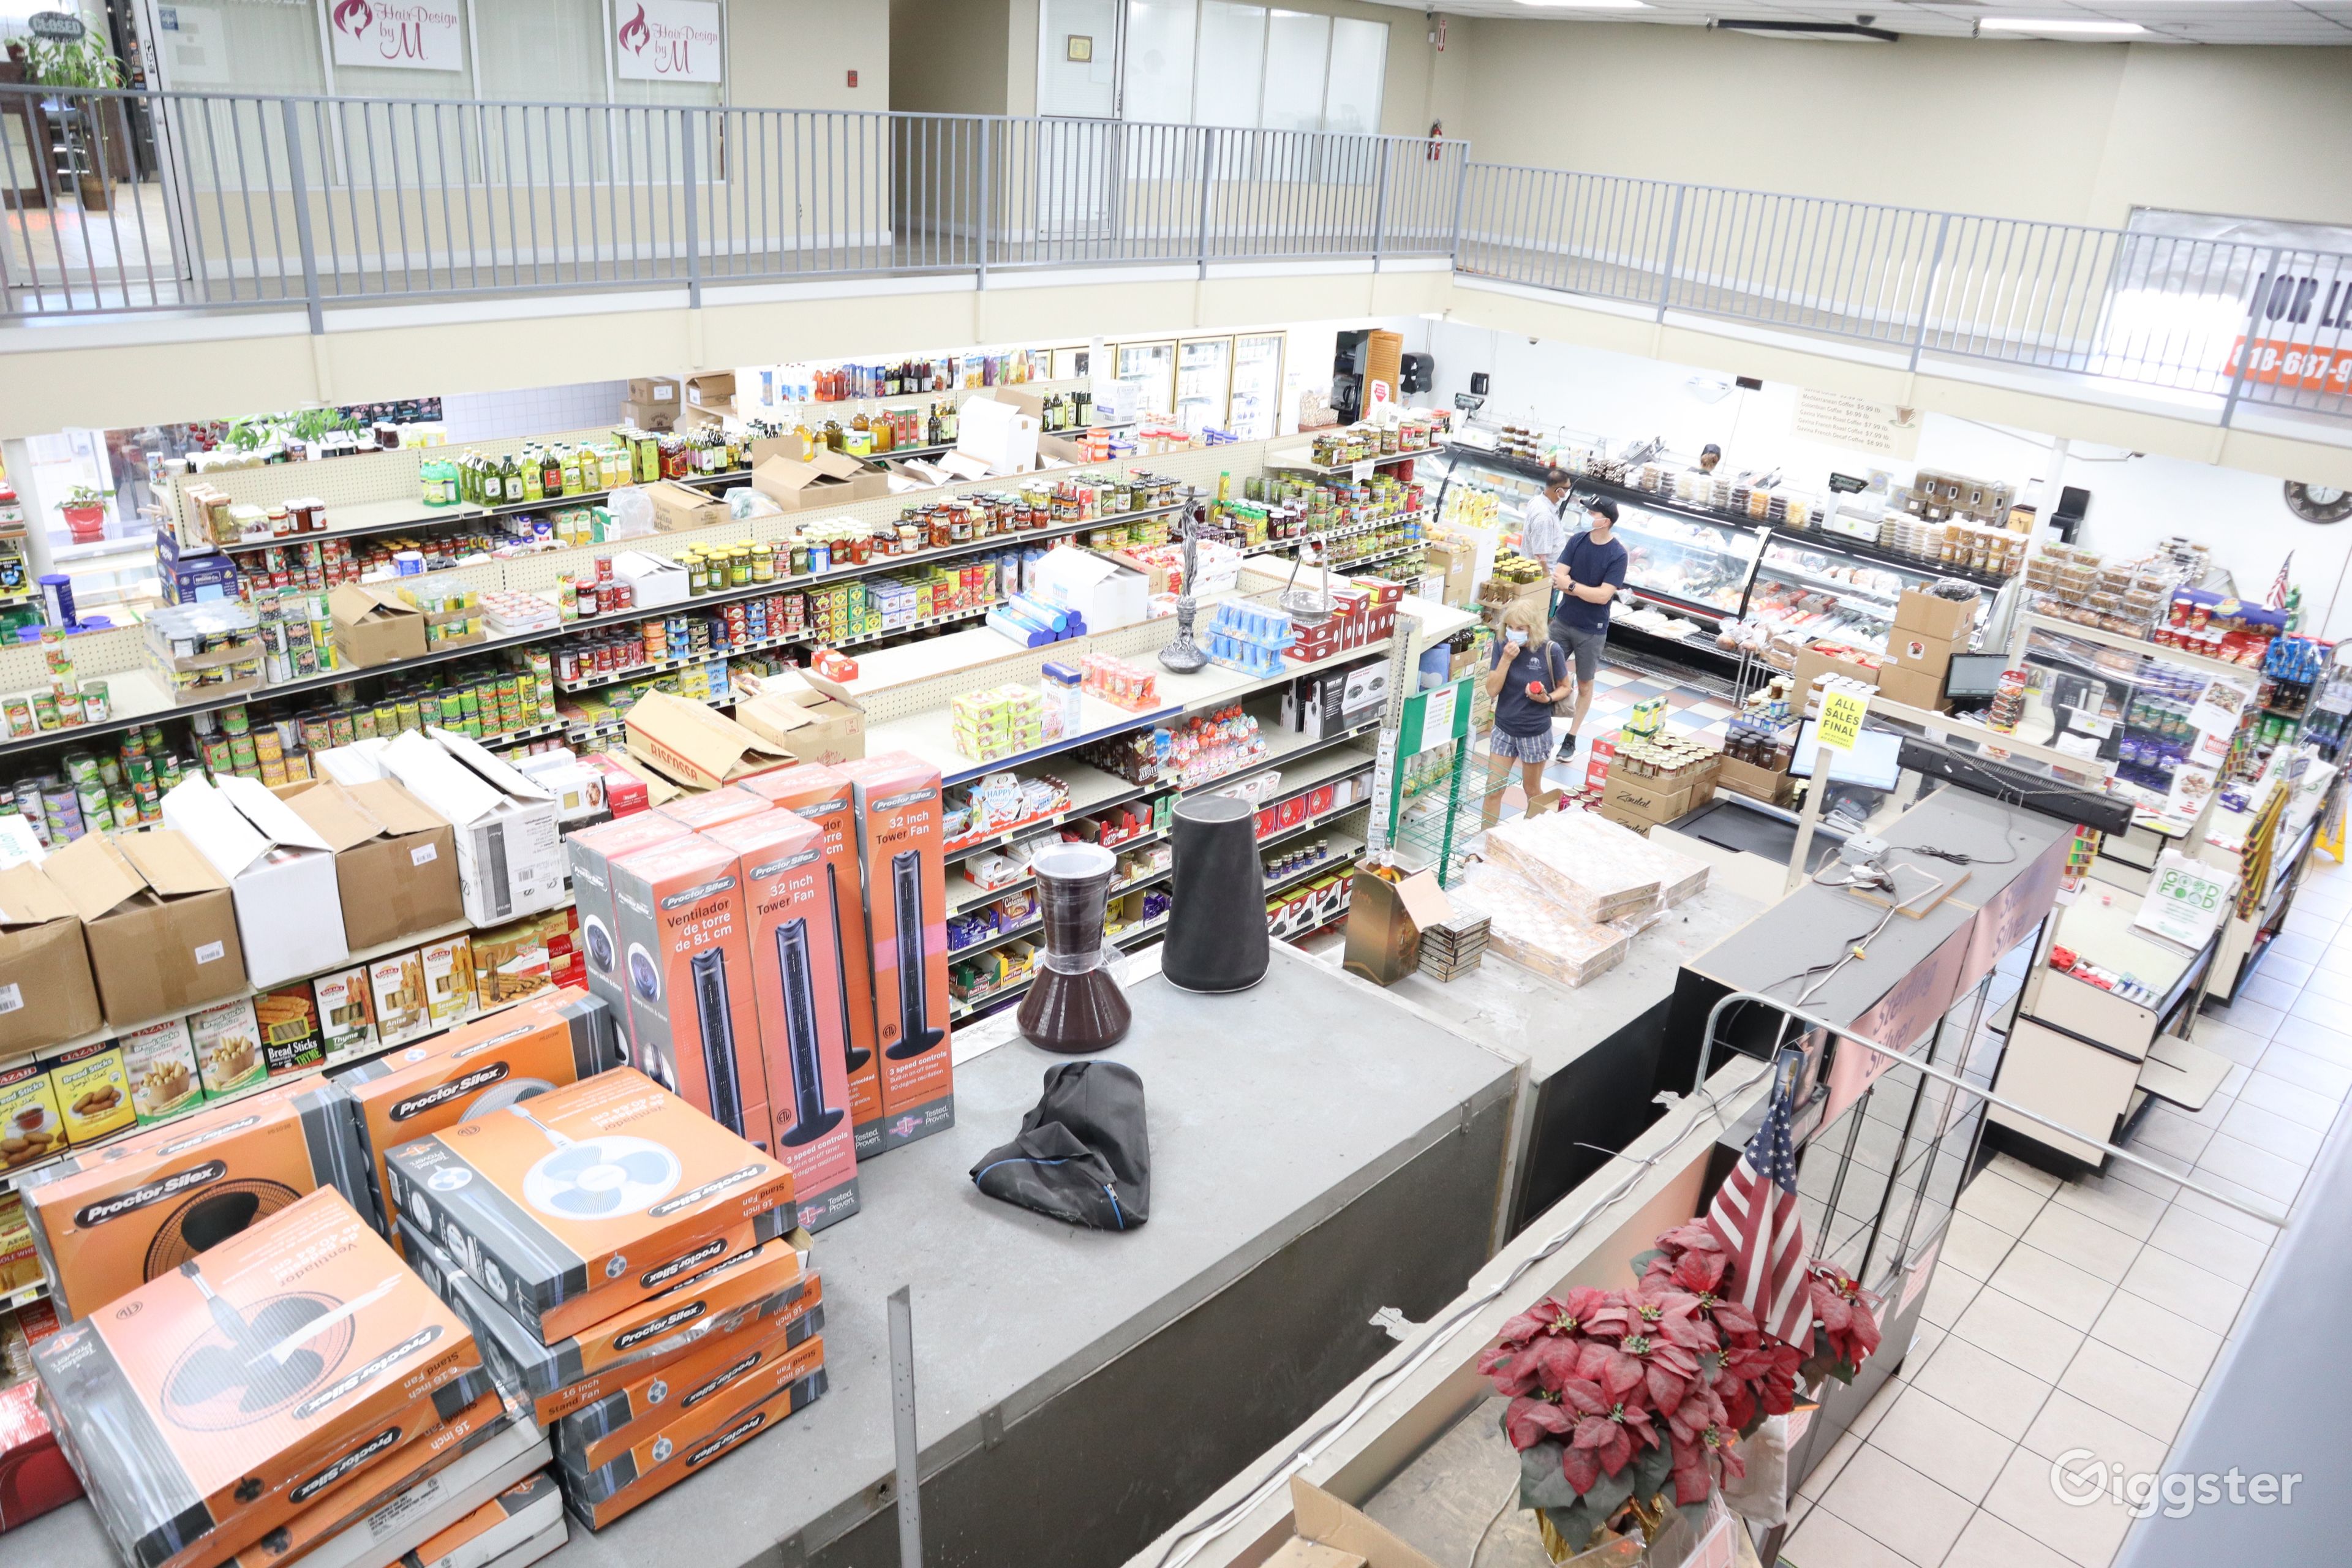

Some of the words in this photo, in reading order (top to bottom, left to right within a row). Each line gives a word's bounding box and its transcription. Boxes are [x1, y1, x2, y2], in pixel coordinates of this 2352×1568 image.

[32, 16, 81, 32] CLOSED
[375, 2, 411, 21] Hair
[411, 7, 459, 26] Design
[380, 26, 395, 43] by
[651, 23, 680, 39] Hair
[680, 26, 718, 43] Design
[655, 43, 668, 58] by
[1801, 401, 1826, 411] Colombian
[1802, 393, 1837, 405] Mediterranean
[1838, 400, 1854, 409] Coffee
[1834, 698, 1856, 712] ALL
[1825, 707, 1860, 726] SALES
[1823, 720, 1855, 737] FINAL
[877, 795, 910, 810] Proctor
[910, 791, 933, 803] Silex
[987, 789, 1012, 797] HAPPY
[889, 816, 904, 829] 32
[907, 810, 929, 824] inch
[876, 829, 907, 845] Tower
[910, 825, 930, 837] Fan
[826, 844, 843, 855] cm
[755, 859, 791, 878] Proctor
[791, 850, 816, 866] Silex
[666, 889, 704, 907] Proctor
[704, 879, 731, 895] Silex
[771, 881, 786, 897] 32
[790, 874, 813, 891] inch
[756, 896, 791, 916] Tower
[794, 889, 815, 904] Fan
[667, 898, 730, 928] Ventilador
[684, 924, 699, 937] de
[702, 913, 731, 929] torre
[675, 940, 690, 952] de
[693, 931, 710, 946] 81
[714, 924, 732, 938] cm
[427, 949, 450, 963] BARAKA
[375, 967, 399, 980] BARAKA
[320, 984, 344, 997] BARAKA
[437, 996, 464, 1011] Sesame
[386, 1016, 407, 1028] Anise
[133, 1039, 156, 1053] Bread
[156, 1030, 179, 1045] Sticks
[333, 1030, 359, 1044] Thyme
[268, 1045, 290, 1060] Bread
[290, 1038, 318, 1054] Sticks
[294, 1048, 323, 1067] THYME
[62, 1069, 88, 1084] Bread
[88, 1057, 115, 1074] Sticks
[890, 1072, 908, 1083] Built-in
[908, 1066, 924, 1078] on-off
[925, 1061, 939, 1071] timer
[896, 1060, 917, 1074] speed
[918, 1050, 948, 1065] controls
[18, 1080, 45, 1098] Sticks
[850, 1074, 875, 1088] velocidad
[890, 1078, 917, 1091] 90-degree
[918, 1068, 944, 1082] oscillation
[399, 1082, 460, 1116] Proctor
[460, 1068, 501, 1091] Silex
[603, 1104, 668, 1131] Ventilador
[924, 1105, 949, 1118] Tested.
[854, 1128, 879, 1141] Tested.
[786, 1156, 793, 1164] 3
[793, 1145, 816, 1162] speed
[817, 1131, 848, 1149] controls
[808, 1150, 826, 1164] on-off
[826, 1144, 840, 1156] timer
[817, 1151, 846, 1167] oscillation
[702, 1166, 759, 1196] Proctor
[760, 1182, 785, 1200] Stand
[88, 1185, 164, 1223] Proctor
[164, 1166, 217, 1193] Silex
[659, 1188, 703, 1212] Silex
[742, 1194, 759, 1207] Fan
[762, 1199, 774, 1210] 16
[827, 1189, 853, 1206] Tested.
[743, 1204, 761, 1218] inch
[280, 1243, 358, 1287] Ventilador
[679, 1242, 722, 1272] Proctor
[648, 1262, 680, 1285] Silex
[620, 1319, 668, 1346] Proctor
[668, 1306, 700, 1325] Silex
[360, 1330, 432, 1380] Proctor
[426, 1351, 460, 1376] Stand
[792, 1349, 816, 1368] Stand
[433, 1370, 451, 1384] 16
[720, 1355, 755, 1383] Proctor
[775, 1362, 792, 1375] Fan
[794, 1364, 806, 1378] 16
[402, 1373, 424, 1390] Fan
[407, 1379, 433, 1400] inch
[562, 1388, 577, 1400] 16
[578, 1378, 600, 1393] inch
[688, 1376, 721, 1401] Silex
[776, 1373, 793, 1386] inch
[307, 1373, 360, 1411] Silex
[548, 1397, 579, 1417] Stand
[581, 1388, 600, 1402] Fan
[455, 1419, 471, 1437] 16
[723, 1414, 760, 1444] Proctor
[430, 1432, 456, 1452] inch
[693, 1438, 725, 1463] Silex
[339, 1431, 394, 1476] Proctor
[301, 1466, 341, 1496] Silex
